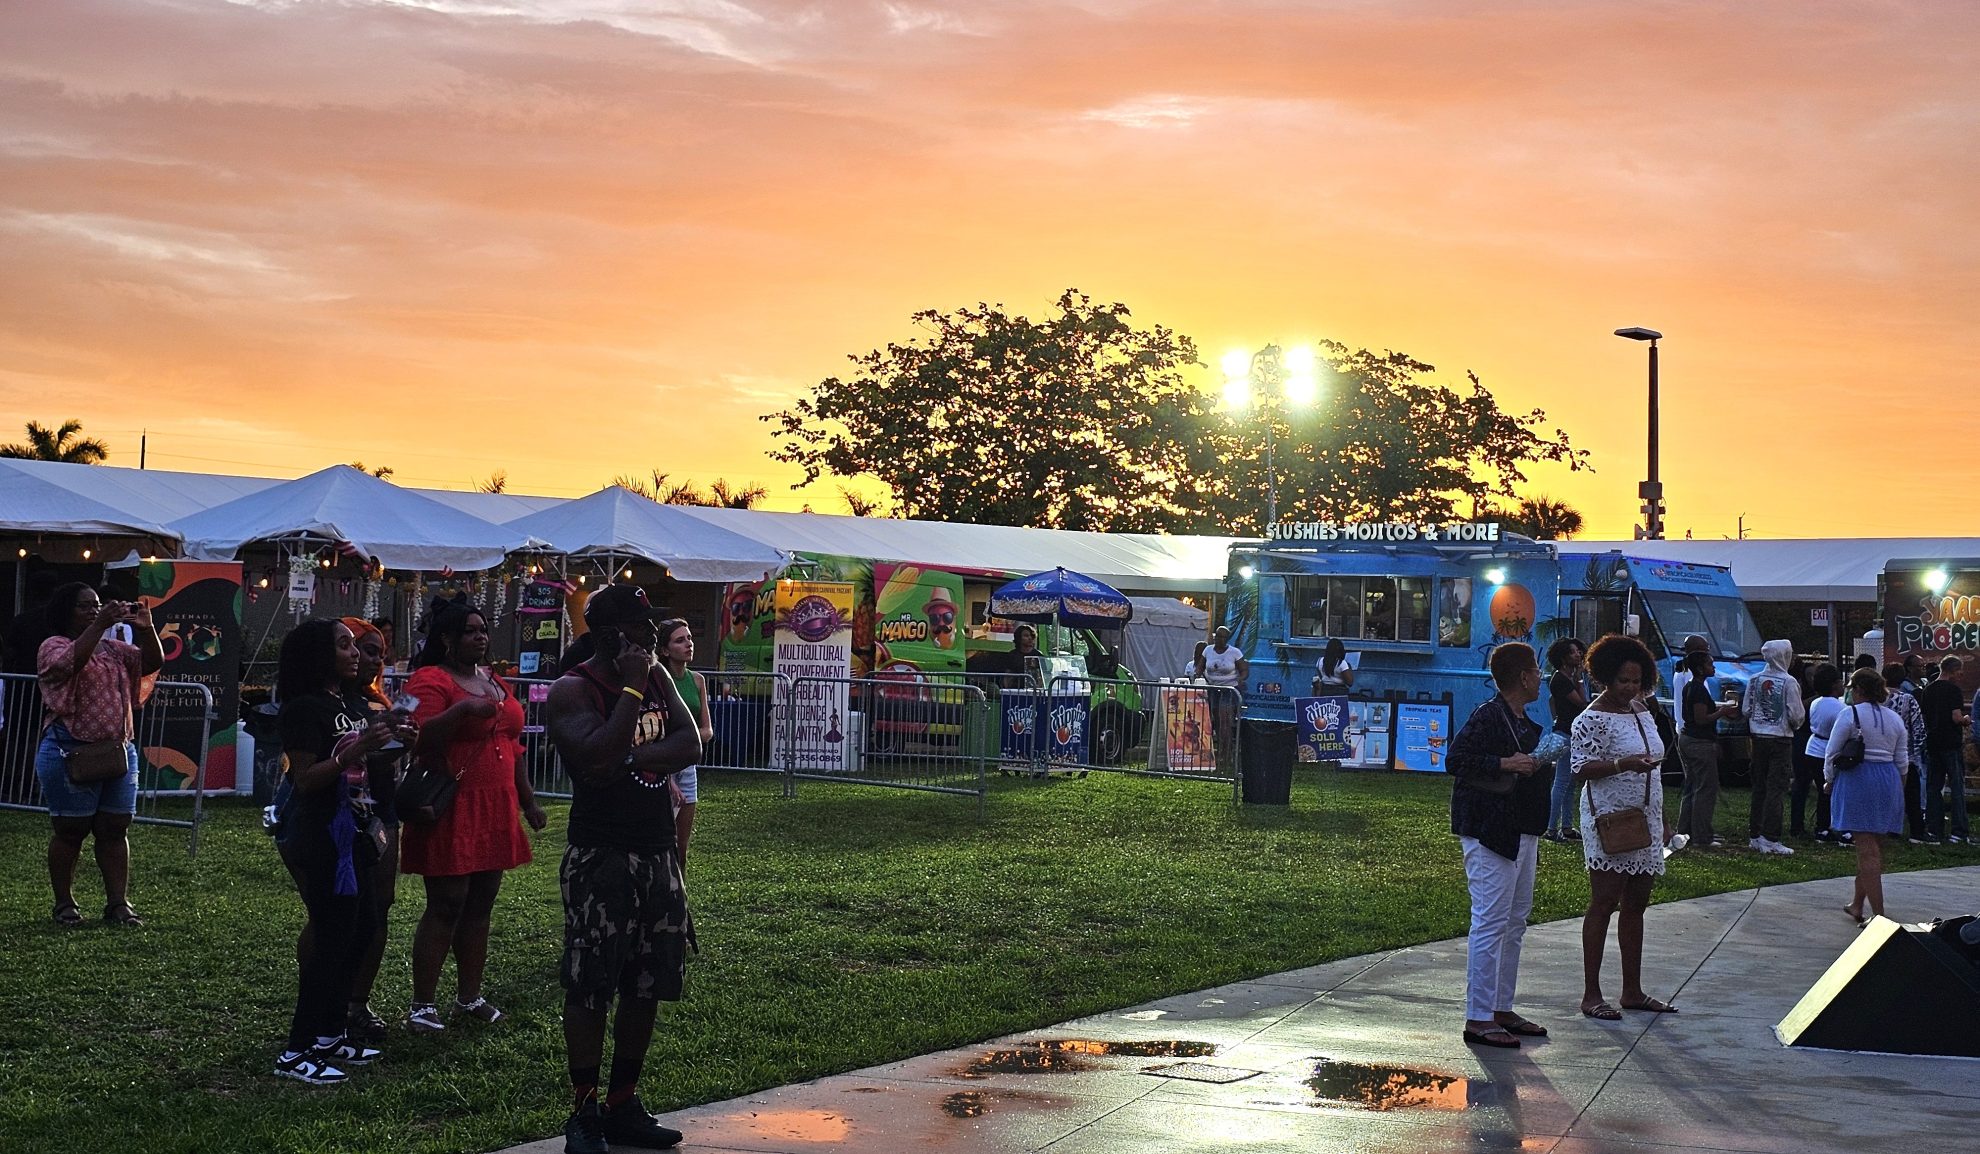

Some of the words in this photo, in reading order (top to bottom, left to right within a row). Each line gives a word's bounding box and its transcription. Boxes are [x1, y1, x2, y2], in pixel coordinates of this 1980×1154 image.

[1265, 522, 1339, 541] SLUSHIES
[1345, 522, 1418, 541] MOJITOS
[1424, 522, 1439, 541] &
[1447, 522, 1499, 541] MORE
[528, 597, 557, 607] DRINKS
[900, 613, 912, 622] MR
[879, 620, 928, 642] MANGO
[1894, 614, 1980, 655] PROPE
[778, 643, 846, 662] MULTICULTURAL
[180, 673, 222, 683] PEOPLE
[777, 664, 846, 679] EMPOWERMENT
[175, 686, 226, 696] JOUREY
[178, 697, 223, 707] FUTUE
[775, 704, 827, 722] COIDENCE
[774, 725, 824, 742] PAANTRY
[1309, 732, 1337, 743] SOLD
[1318, 742, 1346, 752] HERE
